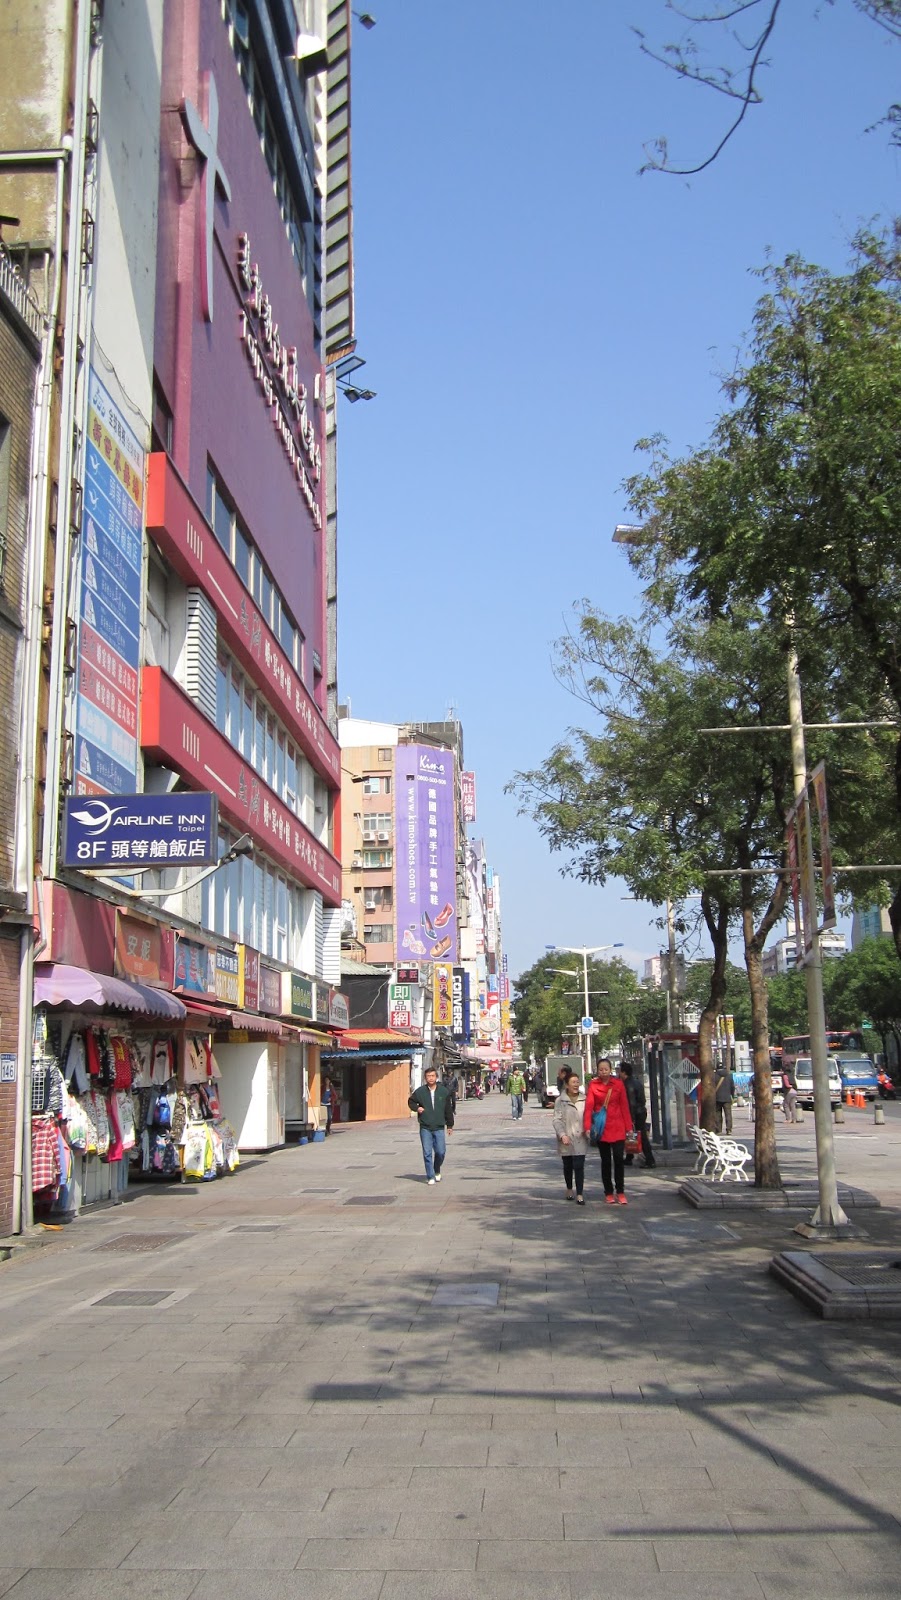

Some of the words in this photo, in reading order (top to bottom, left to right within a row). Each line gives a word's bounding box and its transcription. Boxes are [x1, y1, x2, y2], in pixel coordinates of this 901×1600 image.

[463, 783, 474, 816] 肚皮舞
[113, 815, 173, 826] AIRLINE
[178, 814, 205, 825] INN
[178, 825, 205, 833] Taipei
[77, 841, 107, 859] 8F
[111, 839, 206, 859] 頭等艙飯店
[394, 985, 410, 1027] 即品網
[453, 975, 463, 1034] CONVERSE
[2, 1064, 14, 1078] 146
